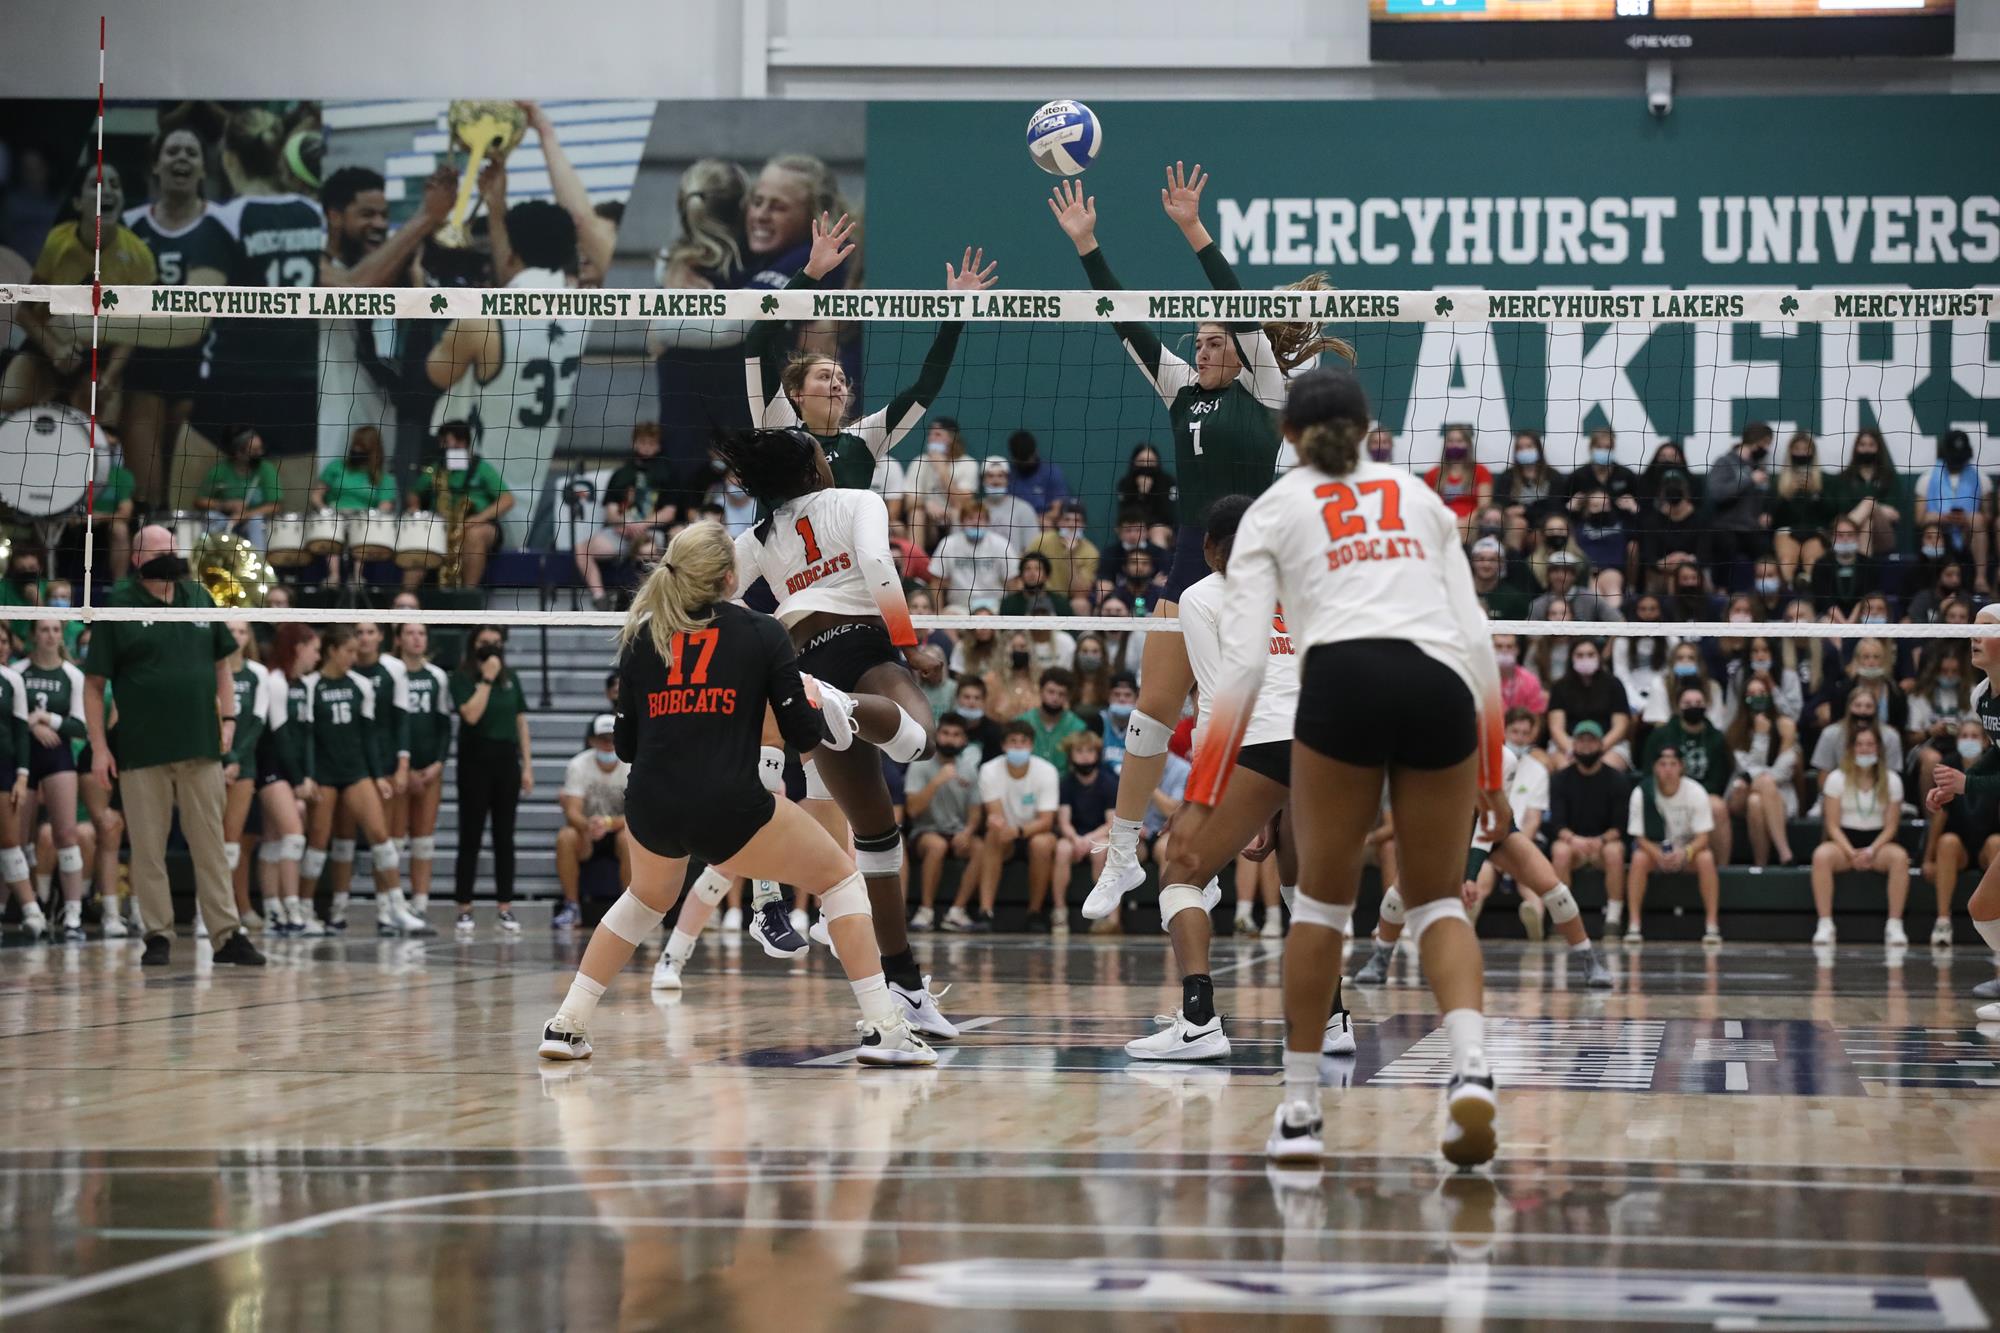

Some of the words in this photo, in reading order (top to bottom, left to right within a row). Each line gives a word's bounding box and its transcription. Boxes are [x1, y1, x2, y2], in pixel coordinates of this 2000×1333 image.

[1031, 105, 1068, 126] molten
[1217, 197, 1677, 265] MERCYHURST
[1698, 196, 2000, 264] UNIVERS
[152, 290, 301, 314] MERCYHURST
[309, 293, 396, 315] LAKERS
[481, 293, 632, 316] MERCYHURST
[638, 294, 727, 316] LAKERS
[813, 295, 965, 318] MERCYHURST
[972, 296, 1061, 318] LAKERS
[1149, 295, 1303, 318] MERCYHURST
[1310, 295, 1400, 317] LAKERS
[1488, 295, 1645, 318] MERCYHURST
[1652, 295, 1744, 318] LAKERS
[1834, 294, 1994, 317] MERCYHURST
[1313, 479, 1406, 542] 27
[795, 515, 822, 566] 1
[1325, 537, 1426, 572] BOBCATS
[785, 552, 852, 595] BOBCATS
[667, 627, 720, 686] 17
[332, 701, 353, 725] 16
[648, 687, 737, 719] BOBCATS
